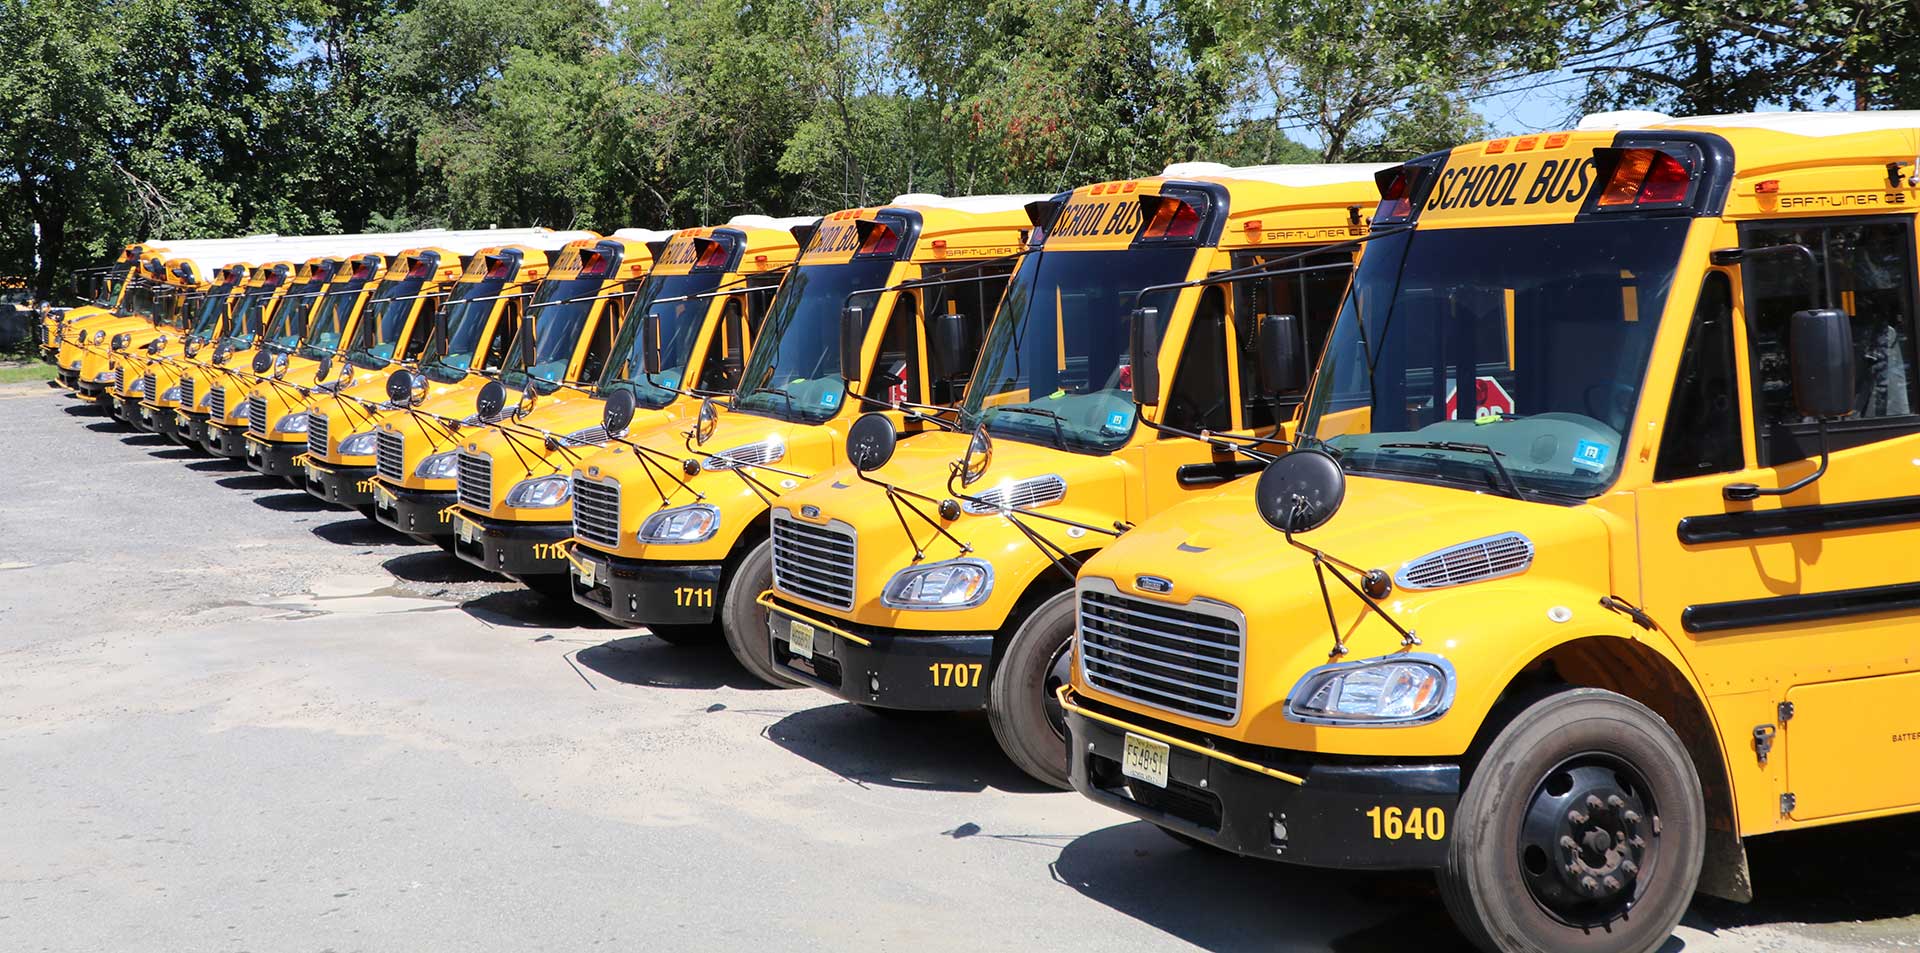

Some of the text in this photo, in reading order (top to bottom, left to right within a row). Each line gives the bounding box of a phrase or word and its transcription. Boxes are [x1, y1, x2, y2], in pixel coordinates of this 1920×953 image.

[1427, 156, 1597, 211] SCHOOL BUS
[1051, 200, 1140, 237] SCHOOL BUS
[673, 587, 712, 607] 1711
[928, 662, 983, 688] 1707
[1366, 805, 1446, 841] 1640
